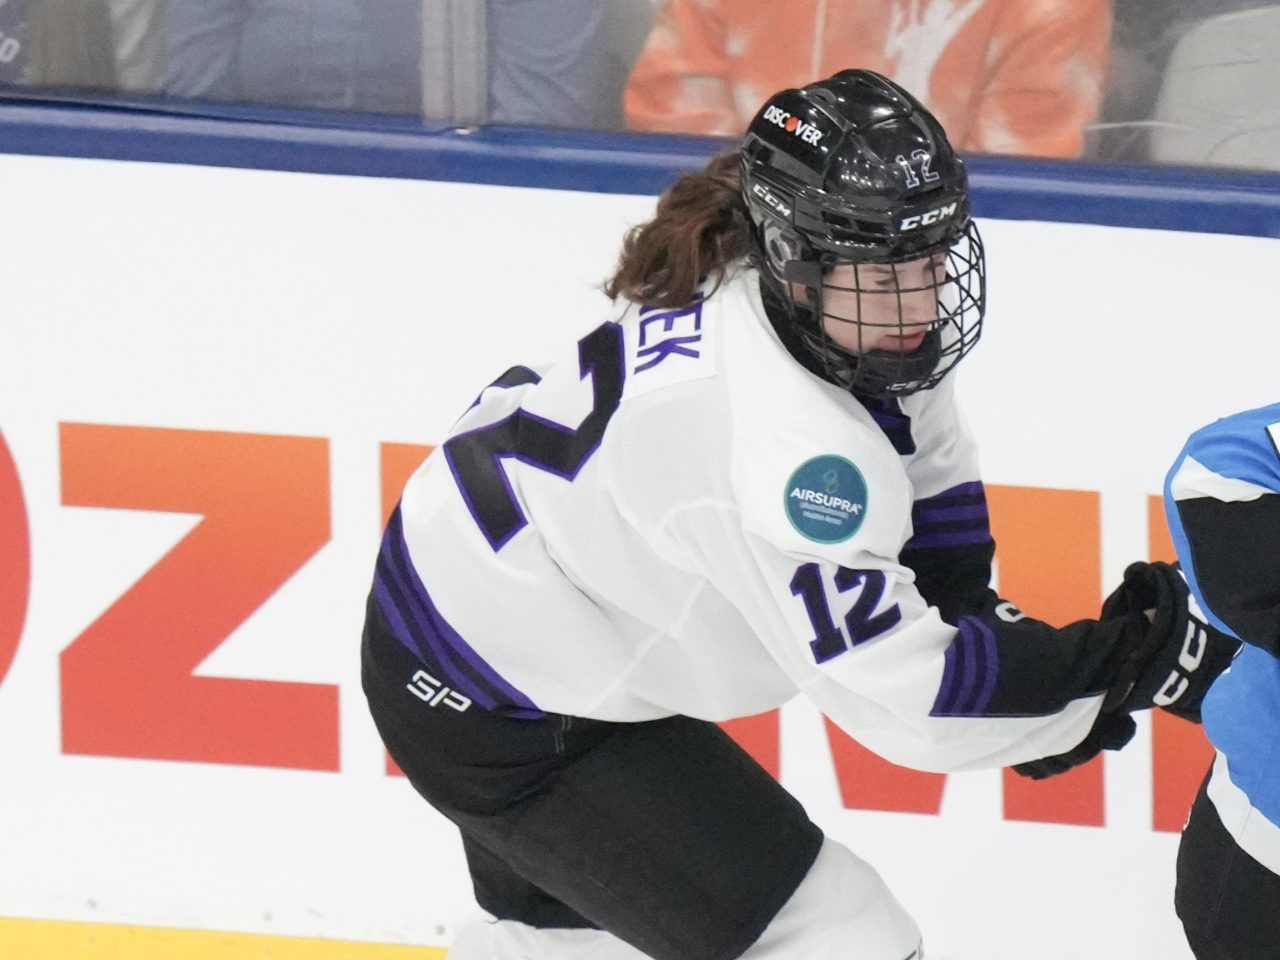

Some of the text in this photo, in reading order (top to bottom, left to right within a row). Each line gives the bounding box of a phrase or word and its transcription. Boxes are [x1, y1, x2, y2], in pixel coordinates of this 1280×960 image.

[764, 104, 824, 147] DISCOVER
[896, 149, 940, 189] 12
[752, 183, 792, 218] CCM
[900, 202, 958, 231] CCM
[789, 562, 902, 665] 12
